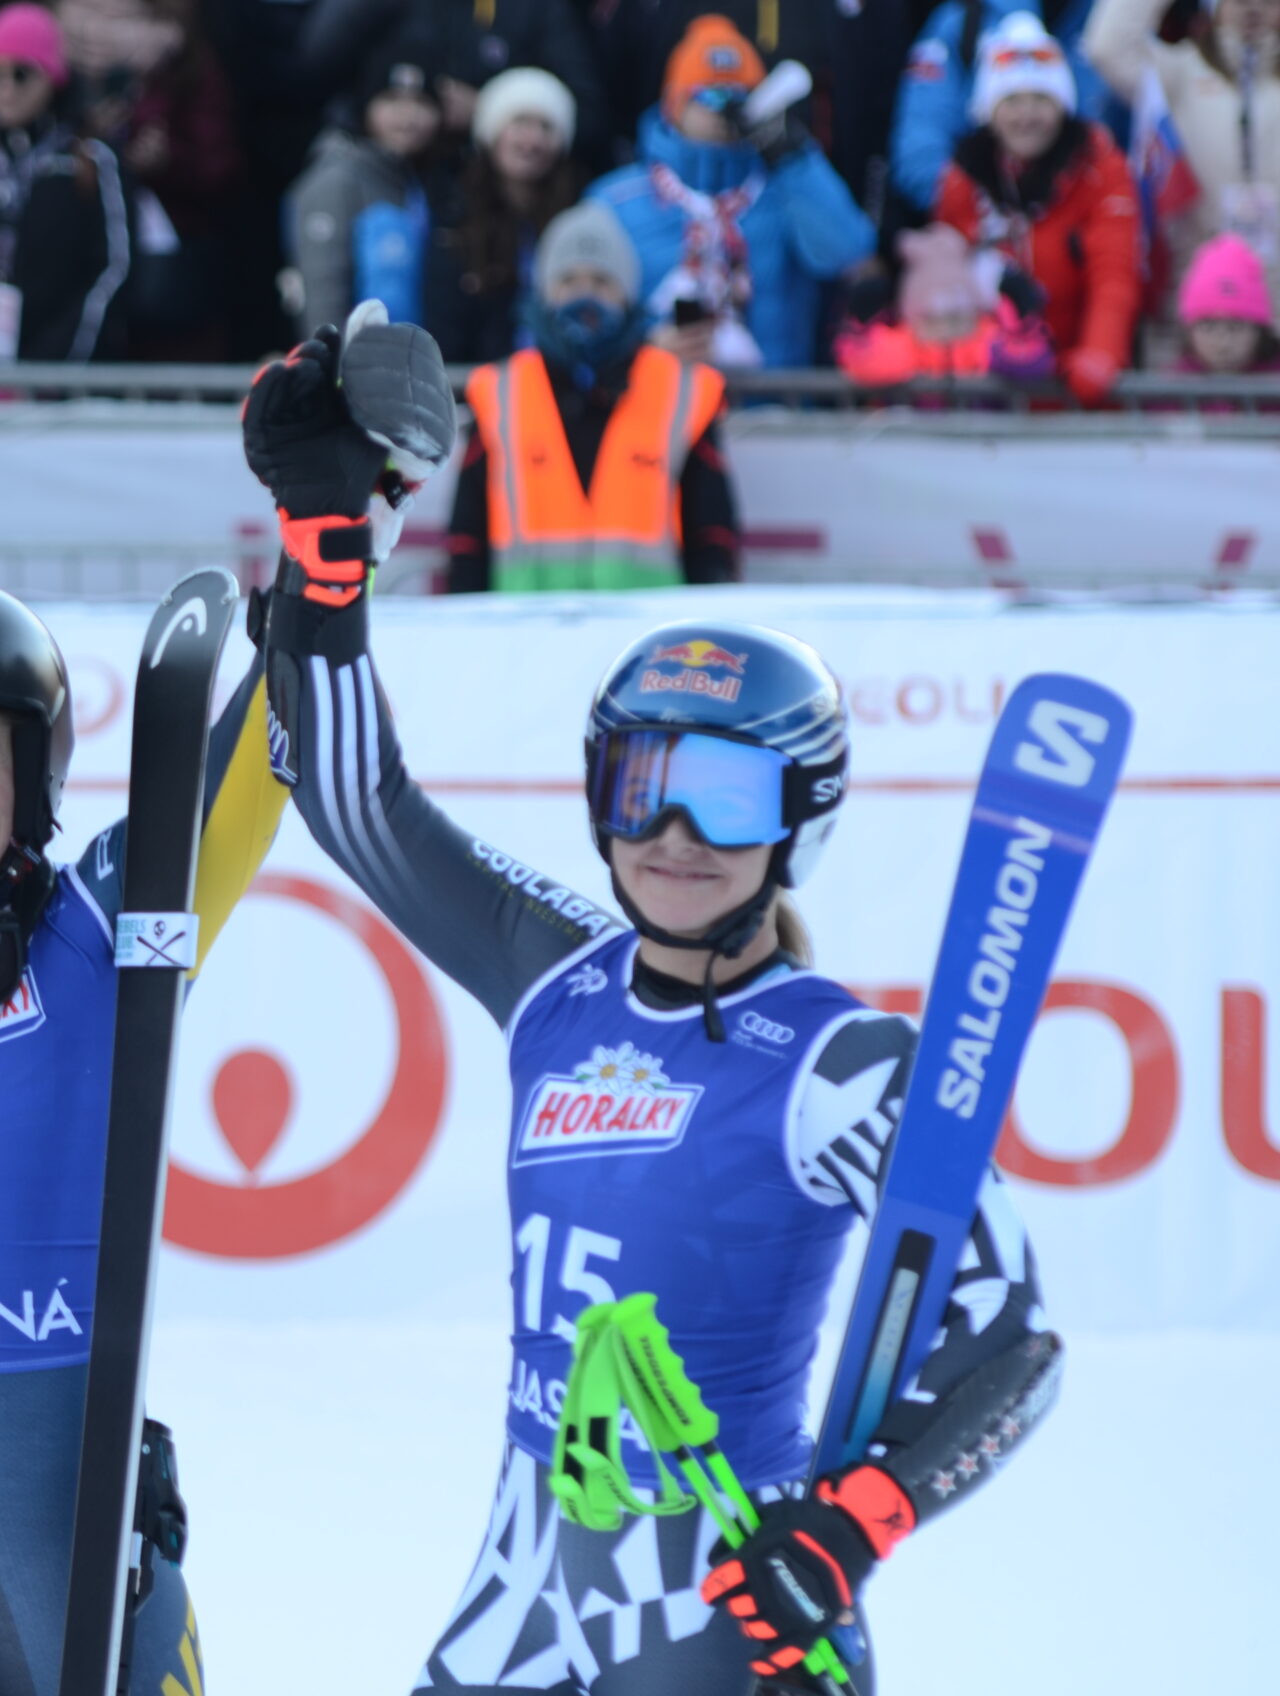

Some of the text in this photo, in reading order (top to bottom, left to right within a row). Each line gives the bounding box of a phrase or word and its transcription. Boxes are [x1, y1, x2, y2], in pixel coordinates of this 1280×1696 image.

[640, 669, 742, 702] Red Bull
[936, 816, 1053, 1119] SALOMON
[533, 1091, 687, 1138] HORALKY
[517, 1212, 622, 1344] 15
